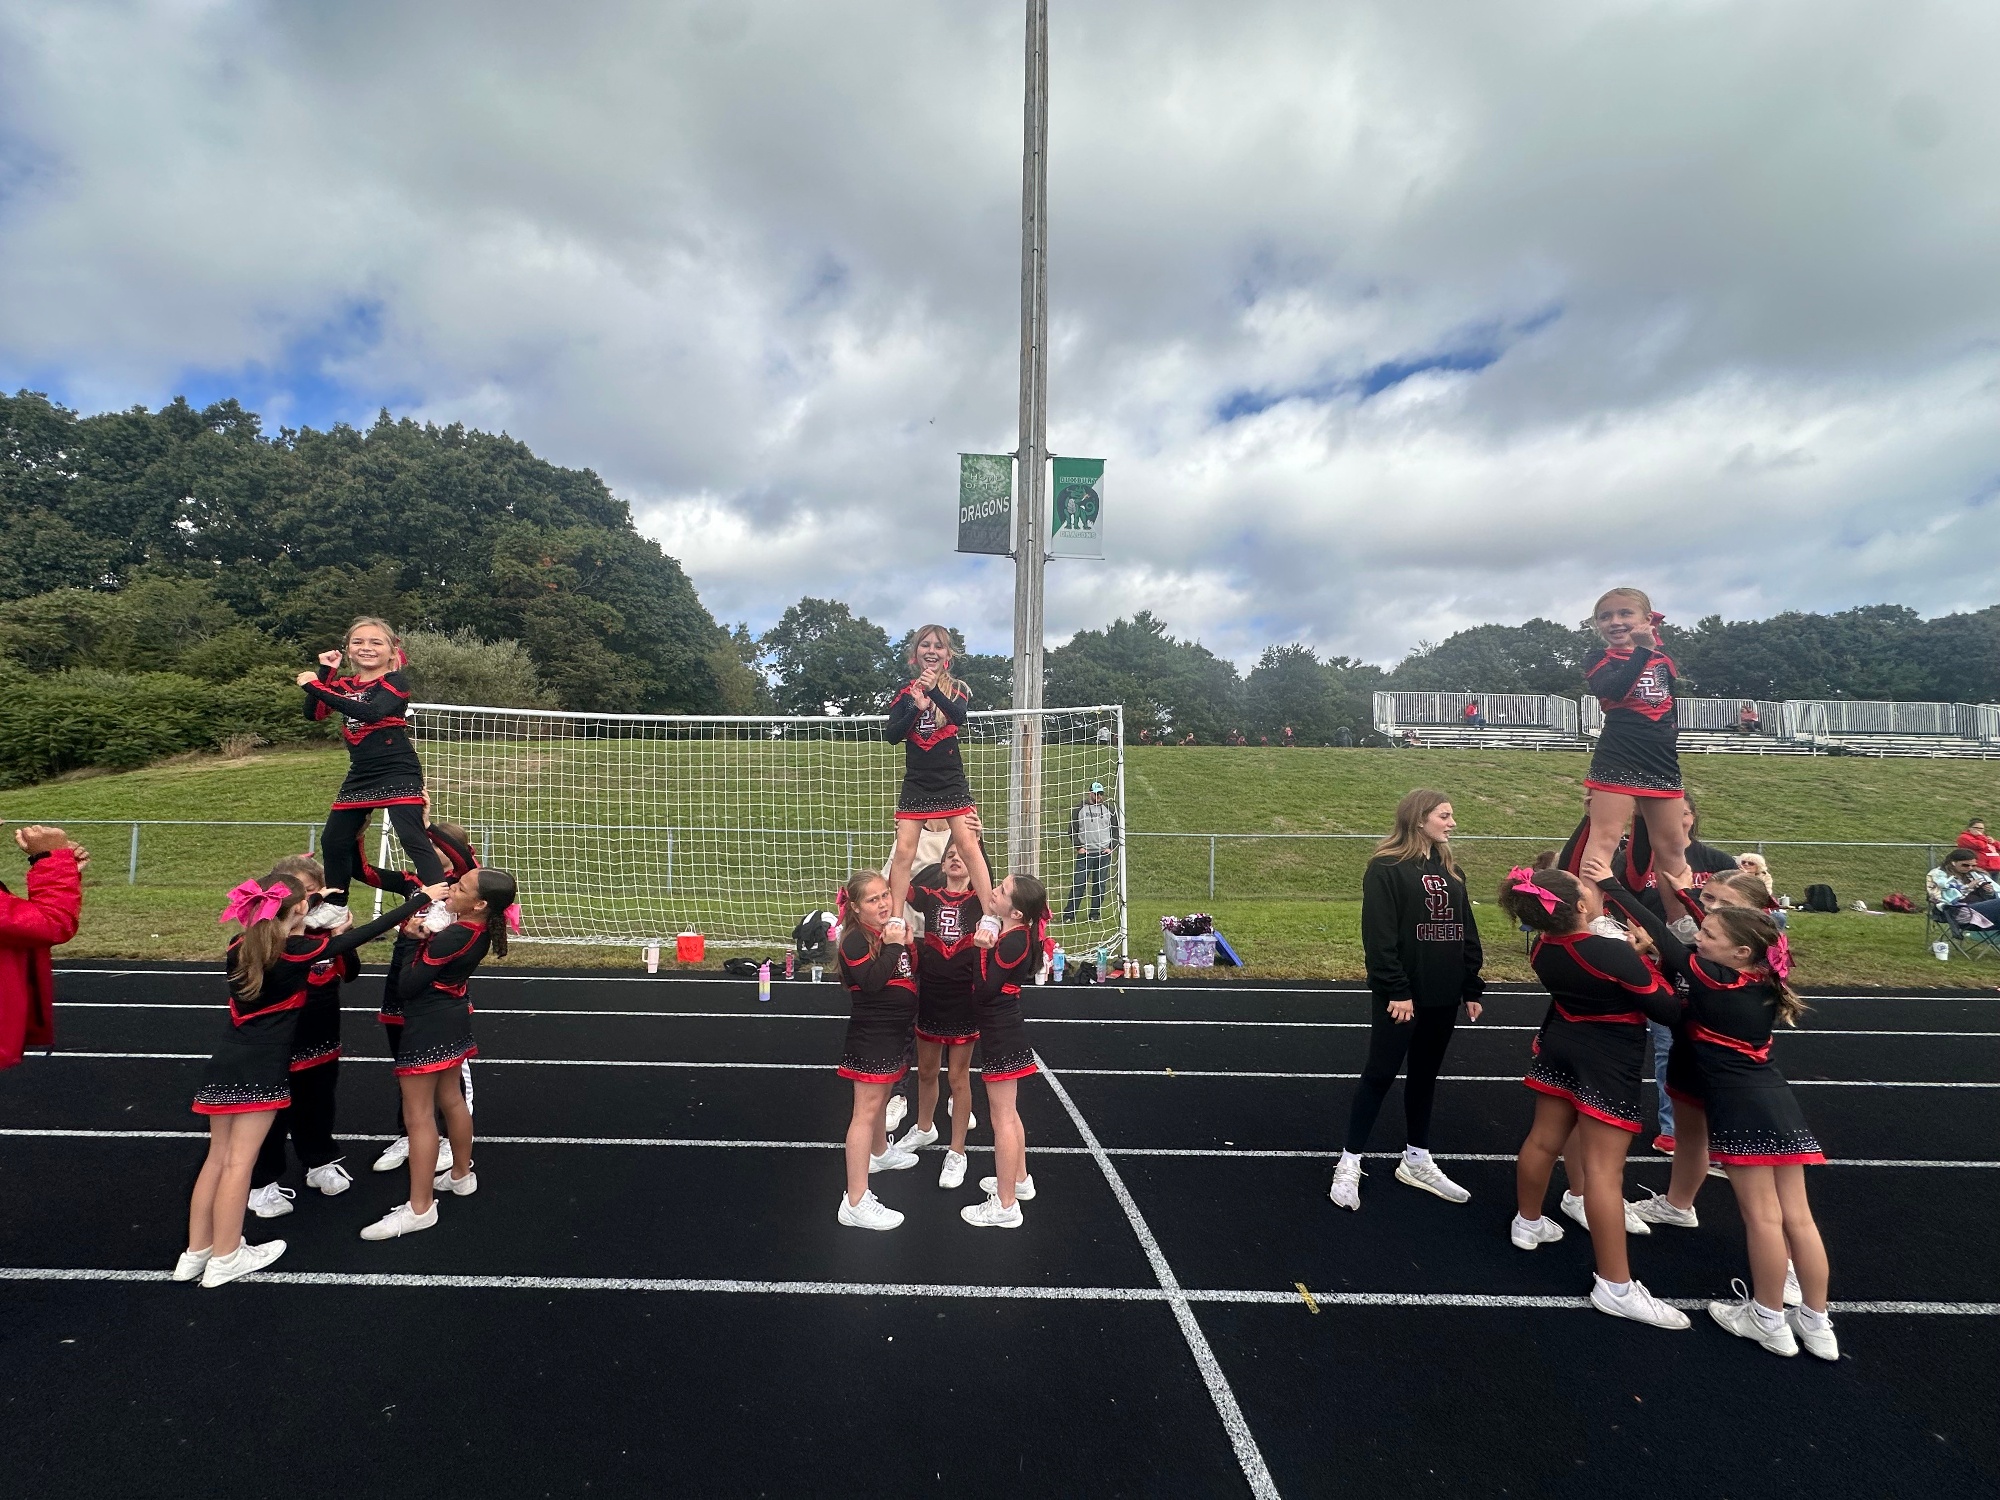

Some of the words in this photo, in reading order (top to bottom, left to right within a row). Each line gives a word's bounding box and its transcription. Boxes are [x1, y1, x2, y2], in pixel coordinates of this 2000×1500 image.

[960, 496, 1010, 524] DRAGONS
[1060, 530, 1097, 540] DRAGONS
[1416, 923, 1464, 942] CHEER
